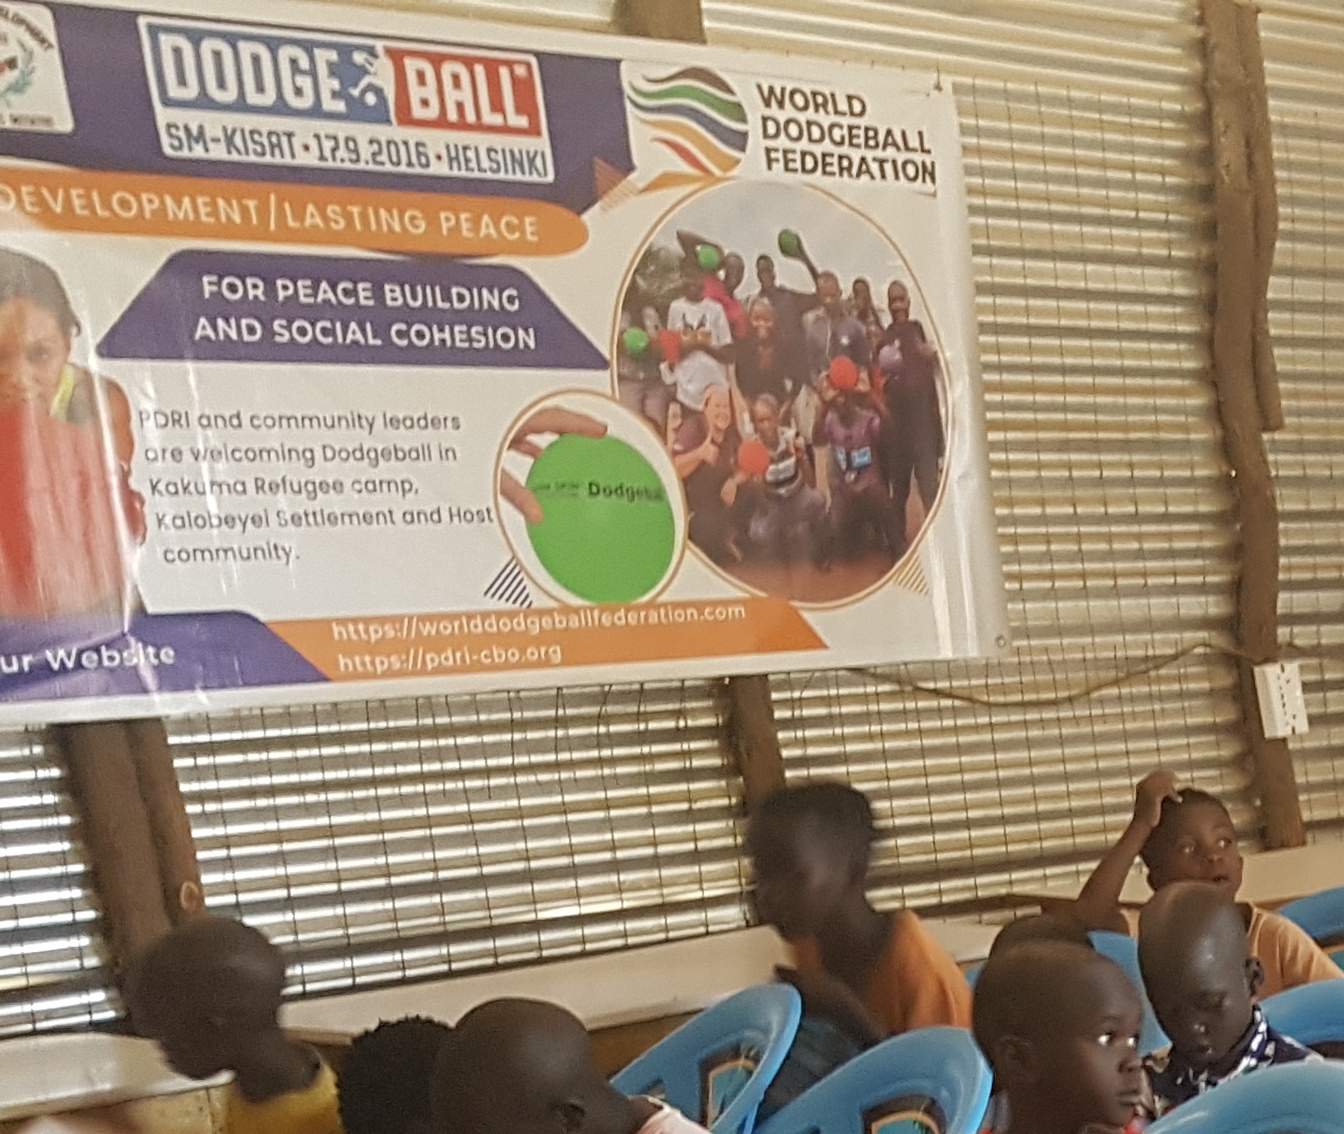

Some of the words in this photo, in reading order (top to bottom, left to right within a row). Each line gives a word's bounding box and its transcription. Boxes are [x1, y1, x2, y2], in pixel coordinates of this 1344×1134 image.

[158, 32, 347, 113] DODGE
[403, 56, 530, 129] BALL
[756, 83, 867, 118] WORLD
[165, 122, 299, 161] SM-KISAT
[444, 142, 548, 178] HELSINKI
[761, 114, 932, 155] DODGEBALL
[765, 146, 937, 185] FEDERATION
[439, 209, 540, 242] PEACE
[201, 274, 266, 302] FOR
[275, 278, 375, 307] PEACE
[384, 282, 520, 312] BUILDING
[194, 315, 262, 343] AND
[272, 318, 382, 347] SOCIAL
[389, 322, 537, 351] COHESION
[139, 410, 190, 430] PDRI
[198, 410, 243, 430] and
[250, 410, 375, 436] community
[383, 411, 461, 431] leaders
[145, 447, 183, 463] are
[190, 442, 316, 469] welcoming
[322, 442, 432, 469] Dodgeball
[438, 443, 458, 462] in
[149, 476, 248, 497] Kakuma
[254, 475, 344, 501] Refugee
[351, 478, 419, 499] camp,
[276, 508, 395, 528] Settlement
[402, 507, 442, 524] and
[449, 506, 494, 524] Host
[163, 540, 300, 567] community.
[332, 604, 746, 643] https://worlddodgeballfederation.com
[45, 641, 176, 672] Website
